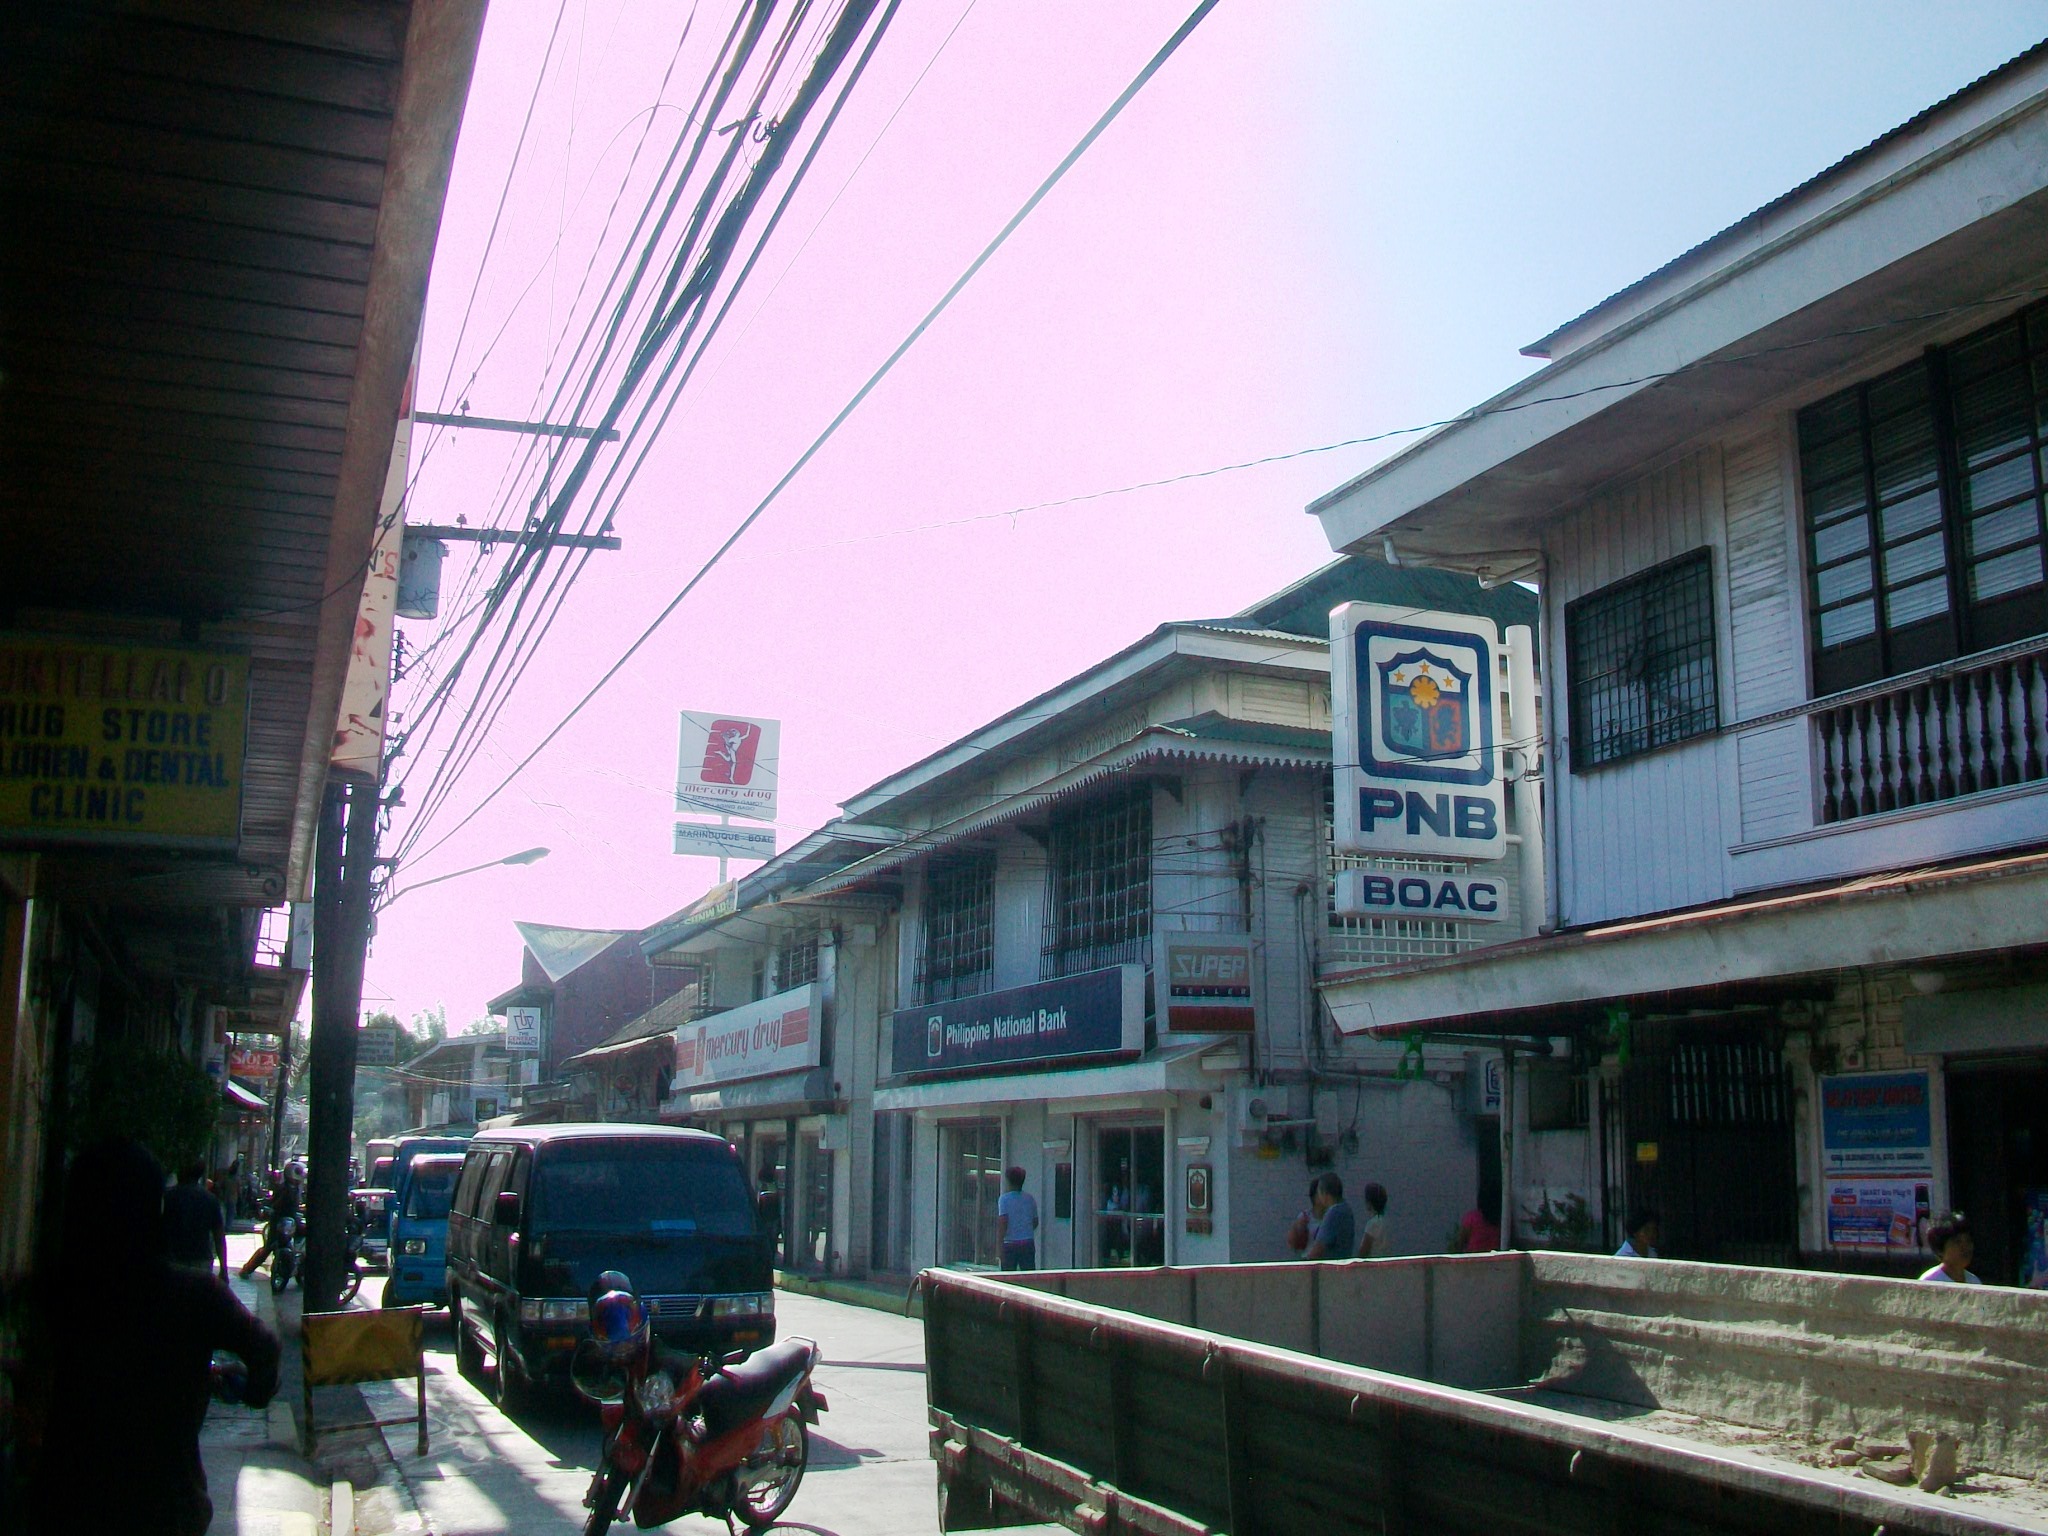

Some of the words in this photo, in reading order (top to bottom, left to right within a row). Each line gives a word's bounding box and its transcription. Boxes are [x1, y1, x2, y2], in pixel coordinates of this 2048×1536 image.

[102, 707, 213, 748] STORE
[124, 748, 230, 788] DENTAL
[30, 782, 146, 825] CLINIC
[684, 784, 739, 798] mercury
[743, 789, 773, 801] drug
[1359, 786, 1498, 841] PNB
[679, 830, 740, 841] MARINDUQUE
[1362, 875, 1498, 913] BOAC
[1174, 954, 1246, 979] SUPER
[1174, 986, 1248, 996] TELLER
[705, 1027, 750, 1060] mercury
[753, 1017, 782, 1053] drug
[945, 1019, 991, 1049] Philippine
[993, 1010, 1035, 1039] National
[1038, 1004, 1068, 1032] Bank
